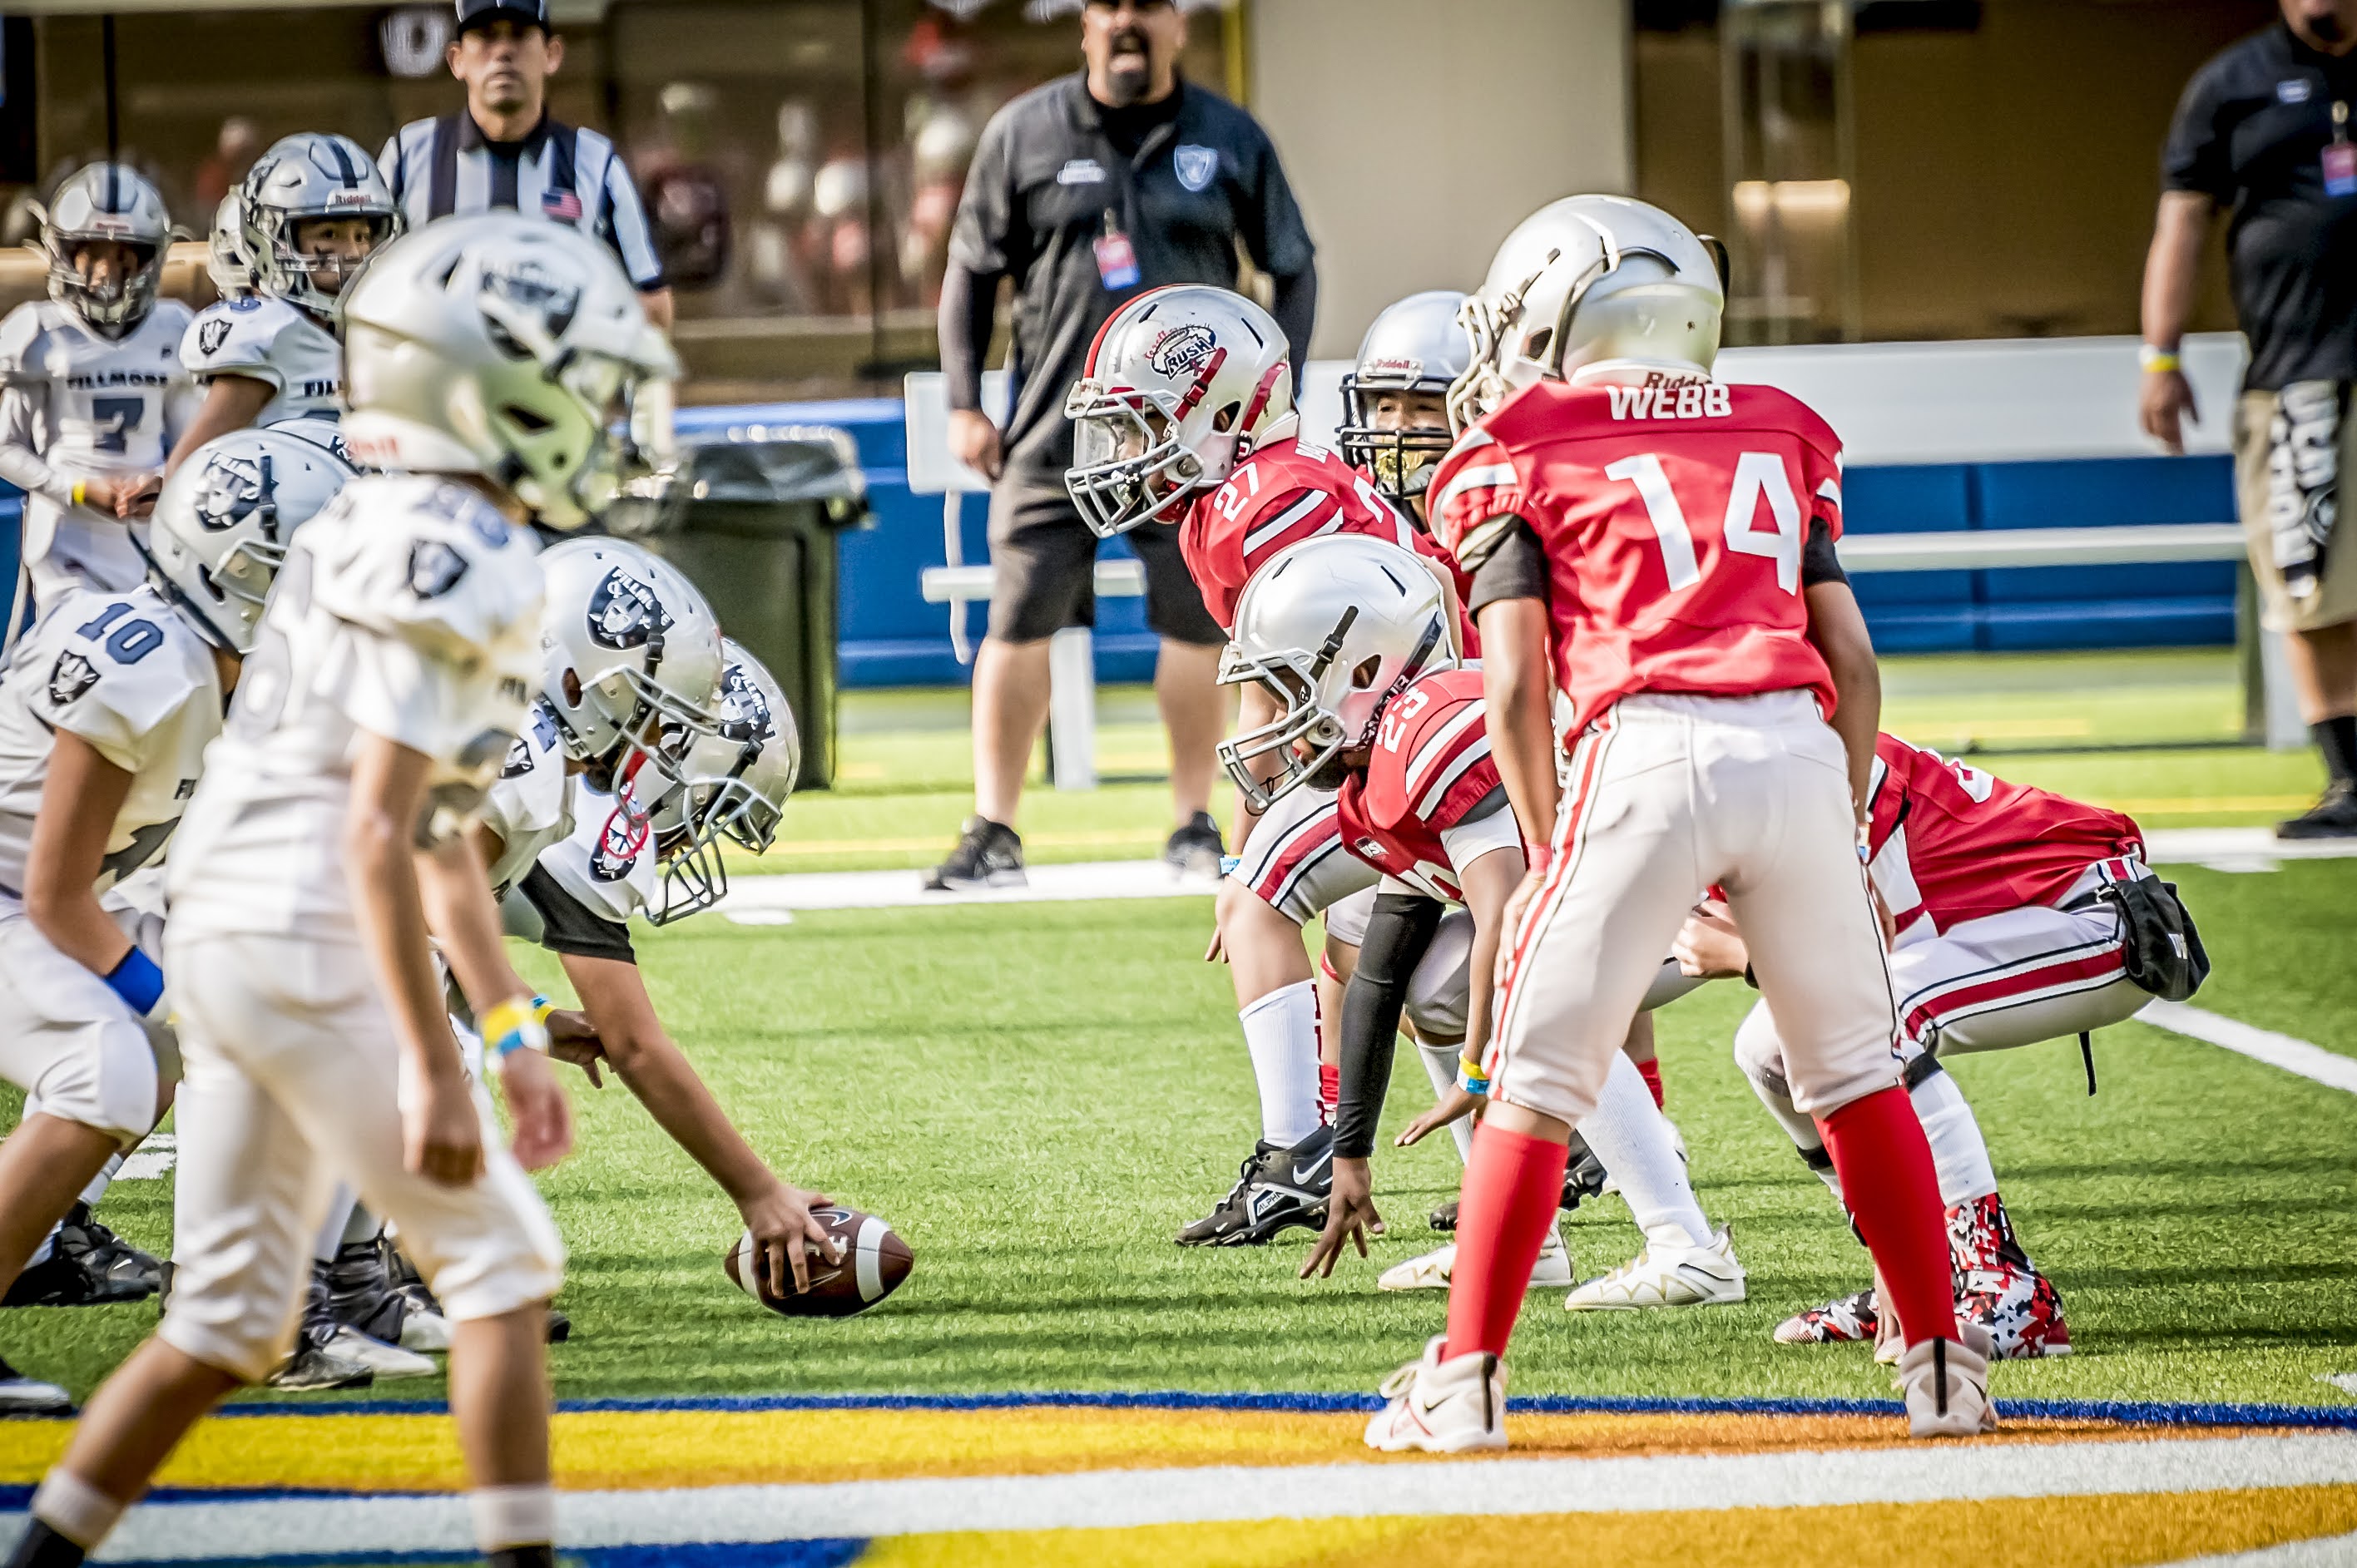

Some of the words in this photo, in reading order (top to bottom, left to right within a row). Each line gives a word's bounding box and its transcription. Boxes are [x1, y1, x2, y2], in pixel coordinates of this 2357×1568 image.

[1167, 339, 1212, 373] RUSH
[93, 397, 143, 452] 7
[1605, 384, 1732, 420] WEBB
[1213, 462, 1260, 522] 27
[1604, 452, 1801, 596] 14
[612, 568, 671, 626] FILLMOE
[76, 602, 164, 665] 10
[735, 668, 774, 734] FILLMOE
[1375, 686, 1429, 754] 23
